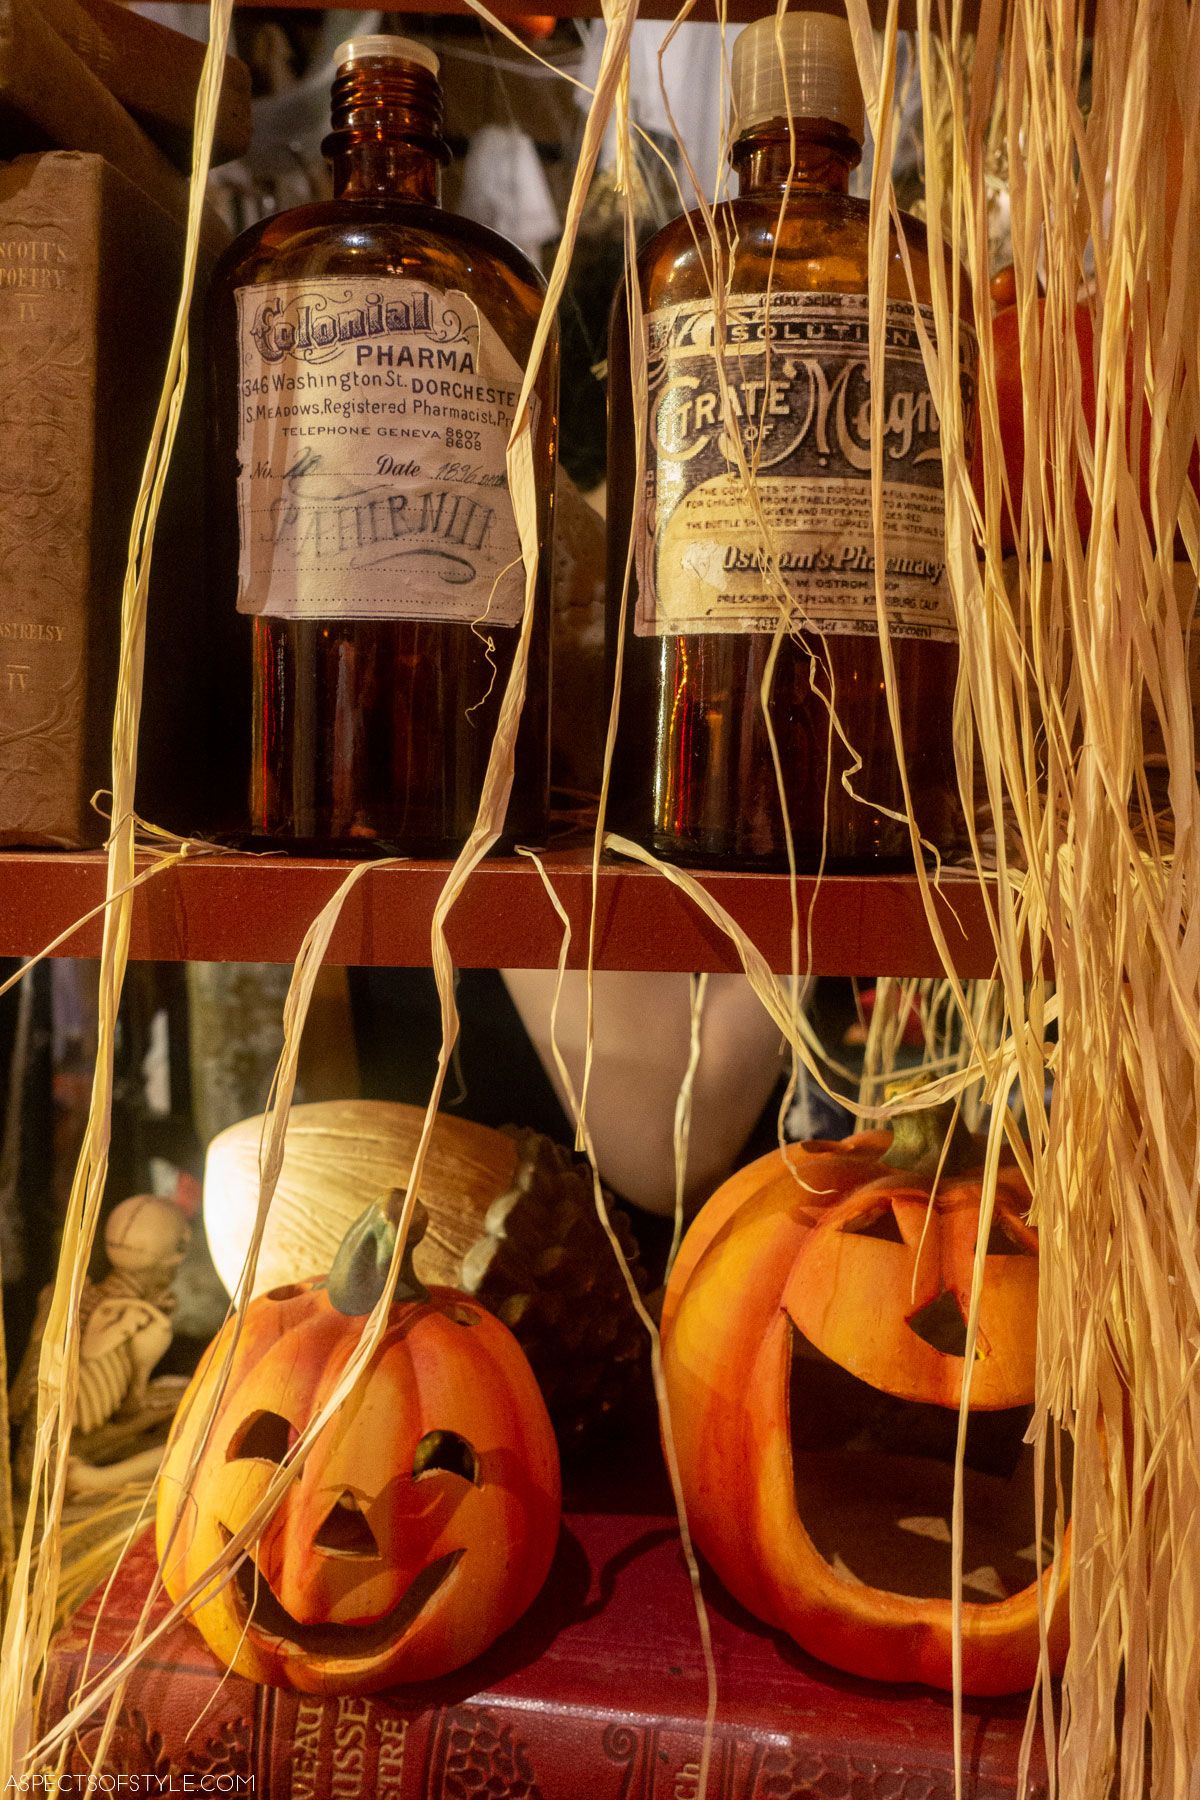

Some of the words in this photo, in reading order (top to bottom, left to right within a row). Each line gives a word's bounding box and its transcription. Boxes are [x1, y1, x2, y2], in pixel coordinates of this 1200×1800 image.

[250, 291, 438, 364] Colonial
[731, 320, 910, 347] SOLUTIN
[356, 345, 475, 374] PHARMA
[244, 376, 269, 397] 346
[272, 371, 382, 391] Washington
[282, 426, 371, 437] TELEPHONE
[377, 427, 441, 440] GENEVA
[446, 427, 480, 441] 8607
[446, 438, 482, 451] 8608
[744, 423, 774, 441] OF
[376, 453, 421, 477] Date
